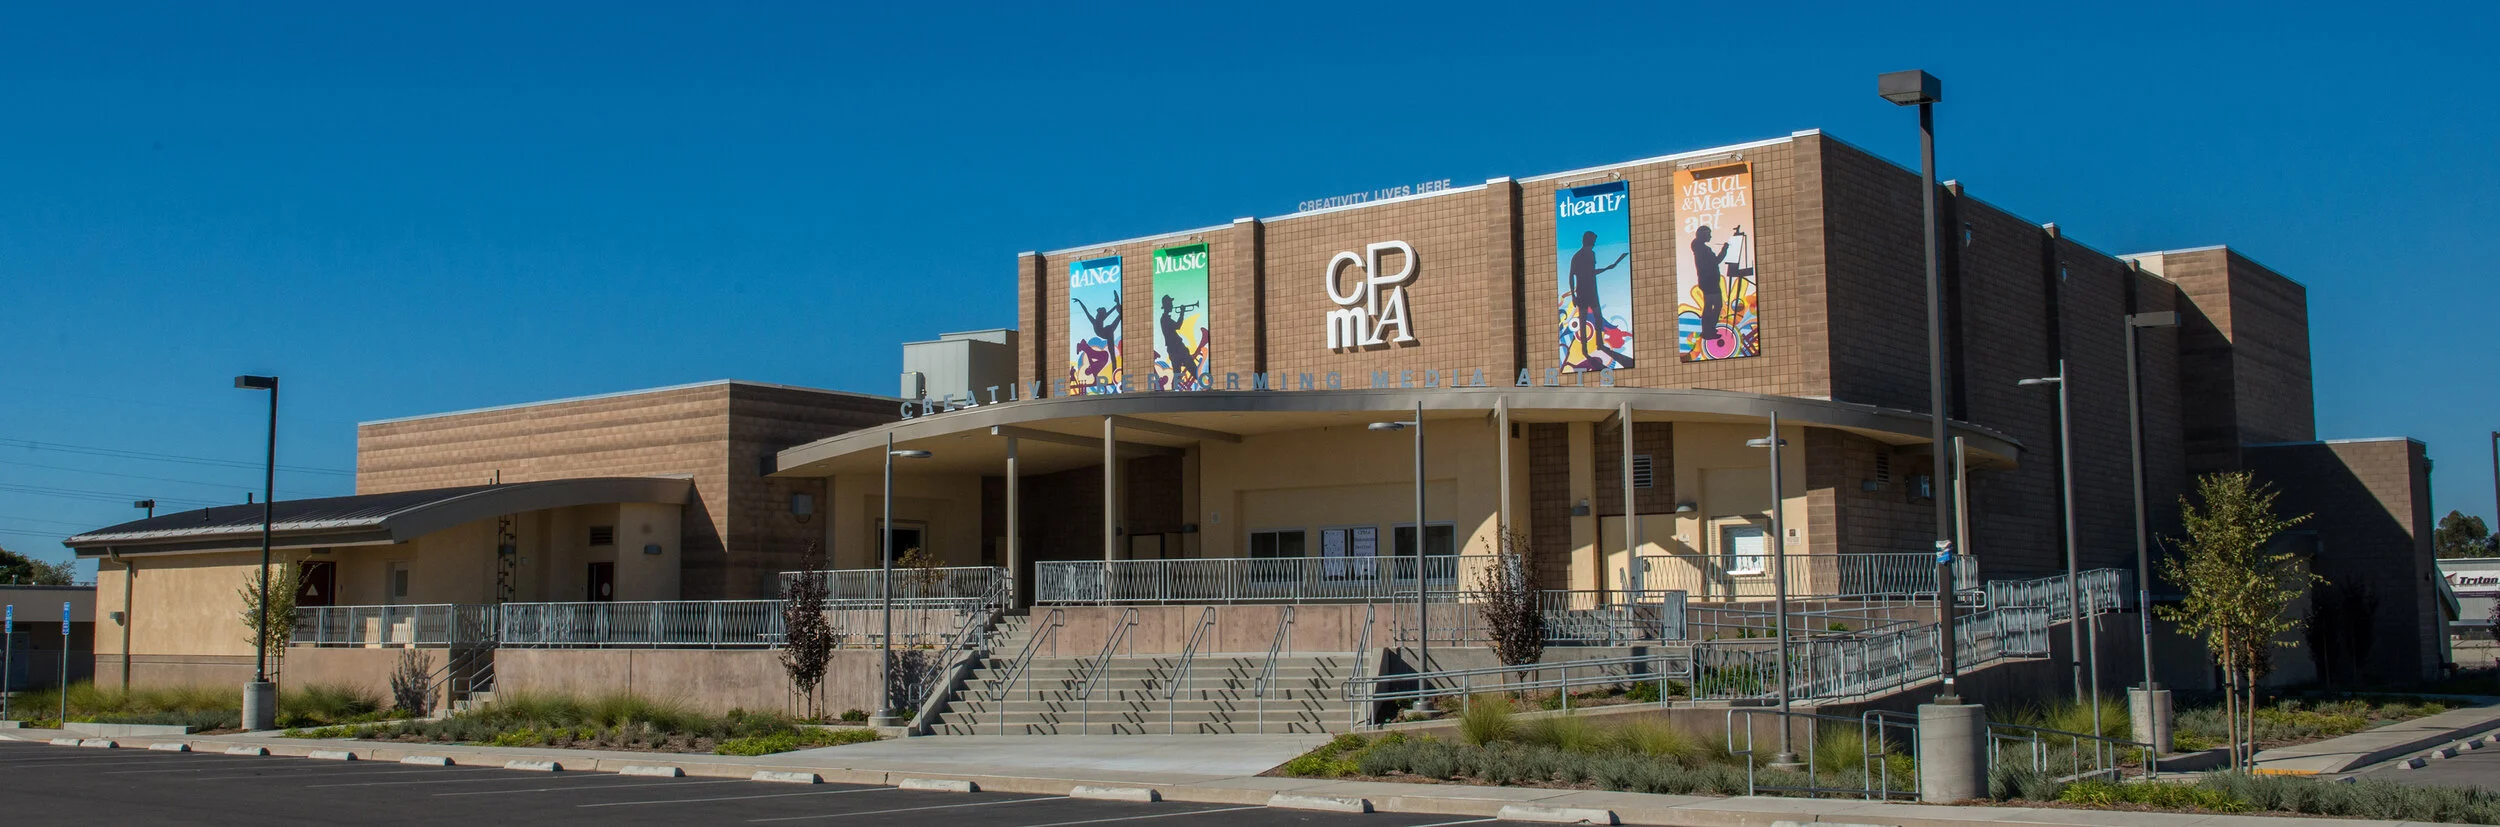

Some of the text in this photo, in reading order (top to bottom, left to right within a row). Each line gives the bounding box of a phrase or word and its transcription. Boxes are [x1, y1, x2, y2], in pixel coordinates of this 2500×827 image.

[1299, 179, 1451, 212] CREATIVITY LIVES HERE
[901, 367, 1615, 420] CREATIVE PERFORMING MEDIA ARTS
[2460, 576, 2499, 585] Triton
